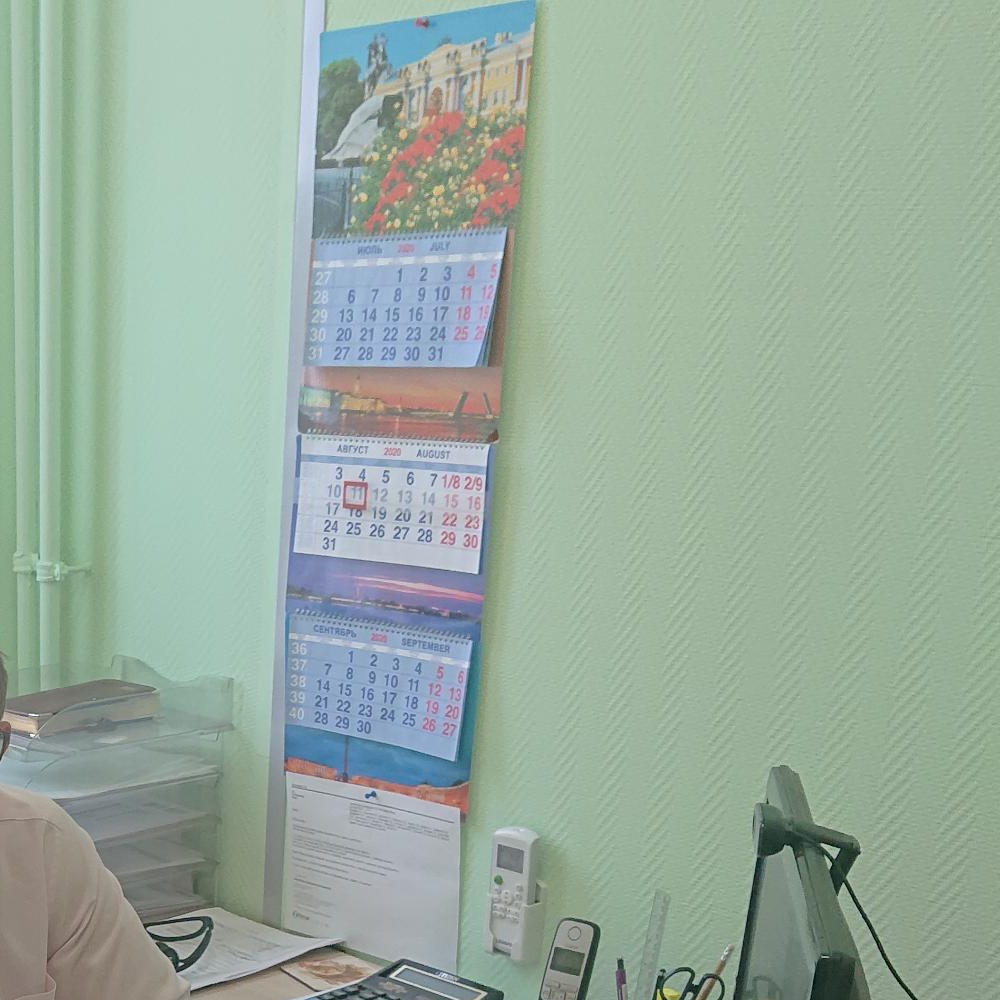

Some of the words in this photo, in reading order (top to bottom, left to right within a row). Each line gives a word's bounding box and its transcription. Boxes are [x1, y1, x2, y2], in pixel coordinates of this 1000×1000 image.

[397, 269, 403, 282] 1
[419, 268, 427, 281] 2
[444, 266, 451, 281] 3
[467, 265, 475, 279] 4
[348, 290, 355, 303] 6
[371, 289, 378, 303] 7
[394, 288, 401, 302] 8
[418, 288, 426, 302] 9
[434, 287, 450, 301] 10
[461, 286, 472, 299] 11
[339, 309, 353, 323] 13
[362, 309, 377, 322] 14
[385, 308, 400, 322] 15
[409, 307, 423, 321] 16
[433, 306, 448, 321] 17
[456, 306, 470, 321] 18
[336, 328, 352, 341] 20
[360, 328, 376, 341] 21
[383, 328, 398, 341] 22
[406, 328, 421, 341] 23
[430, 327, 446, 341] 24
[454, 327, 468, 340] 25
[334, 347, 350, 360] 27
[357, 347, 373, 360] 28
[381, 347, 397, 360] 29
[404, 347, 420, 360] 30
[428, 347, 443, 360] 31
[337, 445, 369, 454] АВГУСТ
[417, 450, 450, 459] AUGUST
[336, 467, 343, 480] 3
[359, 469, 366, 481] 4
[382, 470, 390, 483] 5
[407, 472, 414, 485] 6
[431, 474, 438, 486] 7
[442, 474, 460, 489] 1/8
[464, 476, 483, 490] 2/9
[327, 485, 341, 498] 10
[351, 487, 362, 500] 11
[374, 489, 388, 502] 12
[398, 491, 412, 504] 13
[422, 492, 435, 505] 14
[444, 494, 459, 508] 15
[467, 496, 481, 510] 16
[326, 503, 340, 515] 17
[372, 507, 387, 519] 19
[395, 509, 411, 522] 20
[419, 511, 433, 524] 21
[442, 513, 457, 526] 22
[465, 515, 480, 529] 23
[322, 537, 336, 550] 31
[324, 520, 338, 533] 24
[346, 522, 361, 535] 25
[369, 525, 385, 538] 26
[393, 527, 409, 540] 27
[417, 529, 432, 543] 28
[440, 531, 455, 545] 29
[463, 534, 478, 548] 30
[313, 625, 357, 638] СЕНТЯБРЬ
[402, 638, 450, 653] SEPTEMBER
[349, 651, 354, 662] 1
[370, 654, 377, 666] 2
[393, 658, 399, 670] 3
[415, 663, 422, 675] 4
[436, 666, 443, 679] 5
[458, 671, 464, 683] 6
[324, 664, 332, 675] 7
[346, 668, 353, 680] 8
[369, 672, 376, 683] 9
[384, 674, 398, 688] 10
[408, 679, 419, 692] 11
[428, 684, 441, 696] 12
[450, 688, 461, 701] 13
[317, 679, 330, 692] 14
[339, 683, 352, 696] 15
[361, 687, 374, 700] 16
[382, 691, 397, 704] 17
[404, 696, 418, 709] 18
[426, 701, 439, 714] 19
[445, 705, 459, 719] 20
[314, 712, 328, 725] 28
[335, 716, 349, 729] 29
[357, 720, 371, 734] 30
[315, 696, 328, 709] 21
[336, 700, 350, 713] 22
[358, 704, 372, 717] 23
[380, 708, 395, 721] 24
[402, 713, 416, 727] 25
[423, 718, 435, 732] 26
[442, 723, 457, 736] 27
